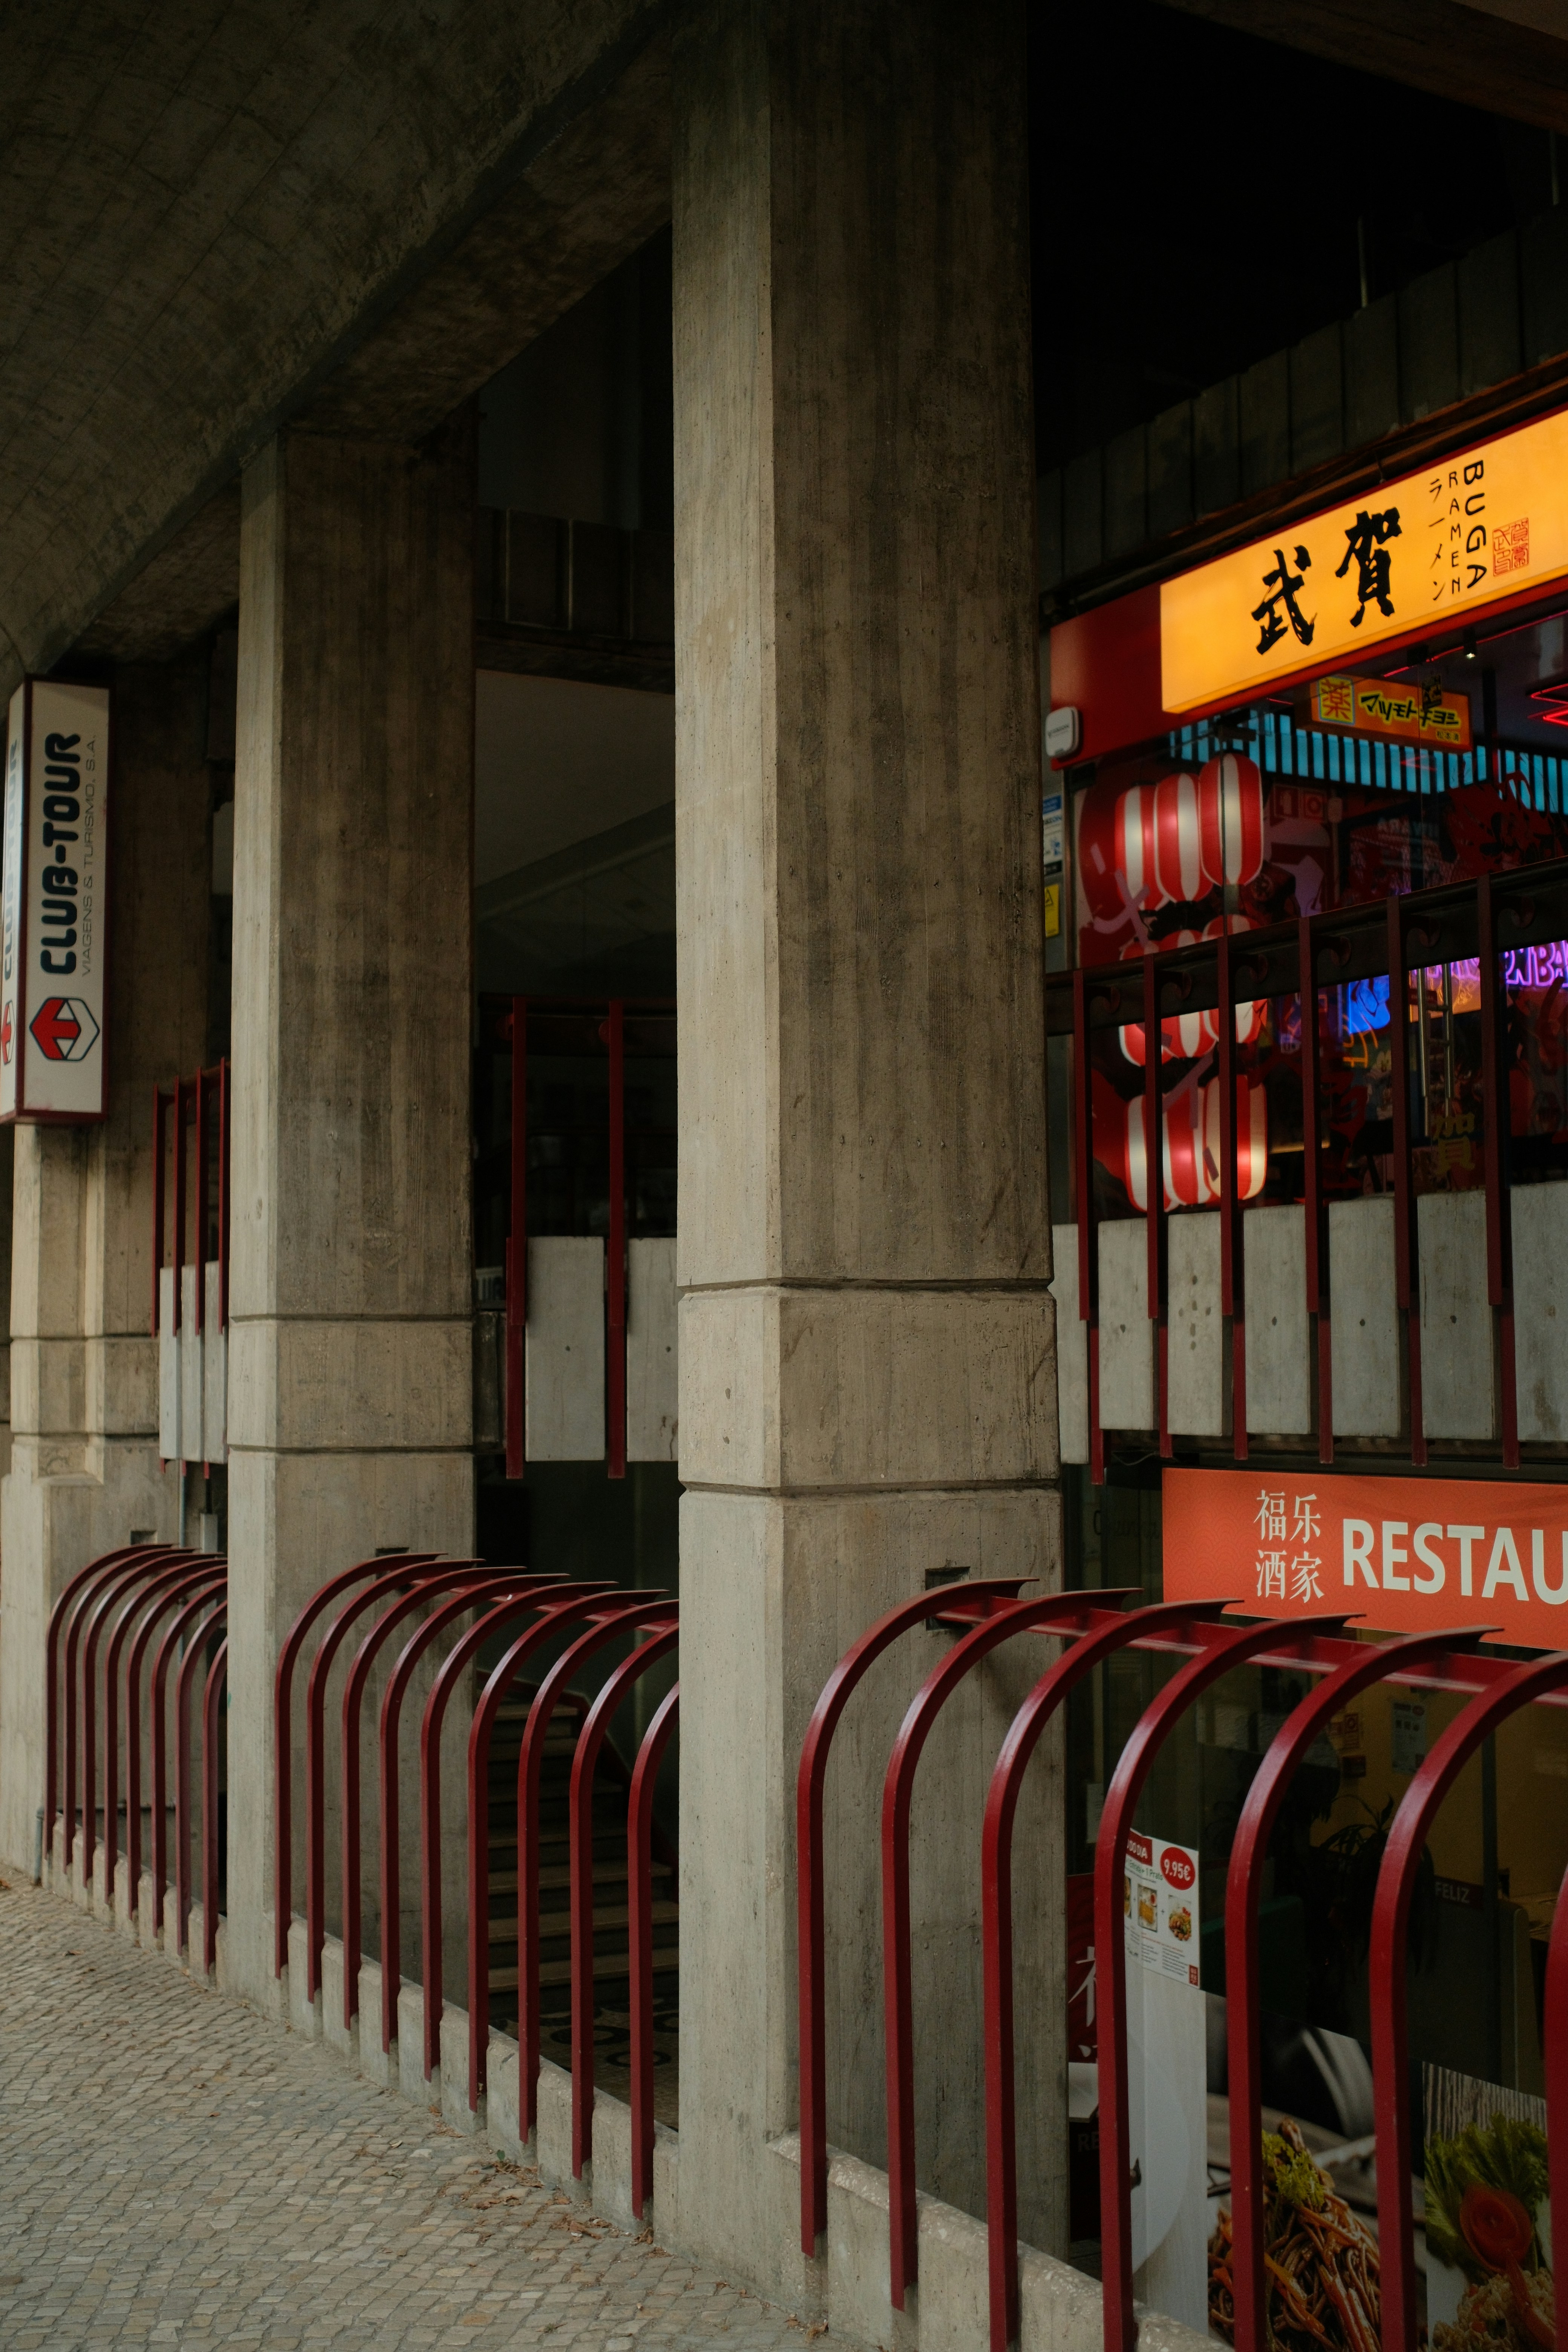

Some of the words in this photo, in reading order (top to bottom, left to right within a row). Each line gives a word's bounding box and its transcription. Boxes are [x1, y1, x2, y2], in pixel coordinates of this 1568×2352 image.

[1429, 479, 1444, 601] ラーメン
[1449, 471, 1461, 594] RAMEN
[1463, 460, 1487, 589] BUGA
[1250, 507, 1403, 655] 武賀
[1321, 678, 1351, 721] 薬
[86, 734, 96, 772] S.A.
[40, 733, 81, 975] CLUB-TOUR
[83, 875, 93, 890] &
[81, 895, 92, 978] VIAGENS
[1253, 1489, 1321, 1544] 福乐
[1255, 1549, 1325, 1603] 酒家
[1343, 1518, 1568, 1605] RESTAU
[1164, 1858, 1191, 1882] 9.95€
[1435, 1881, 1470, 1903] FELIZ
